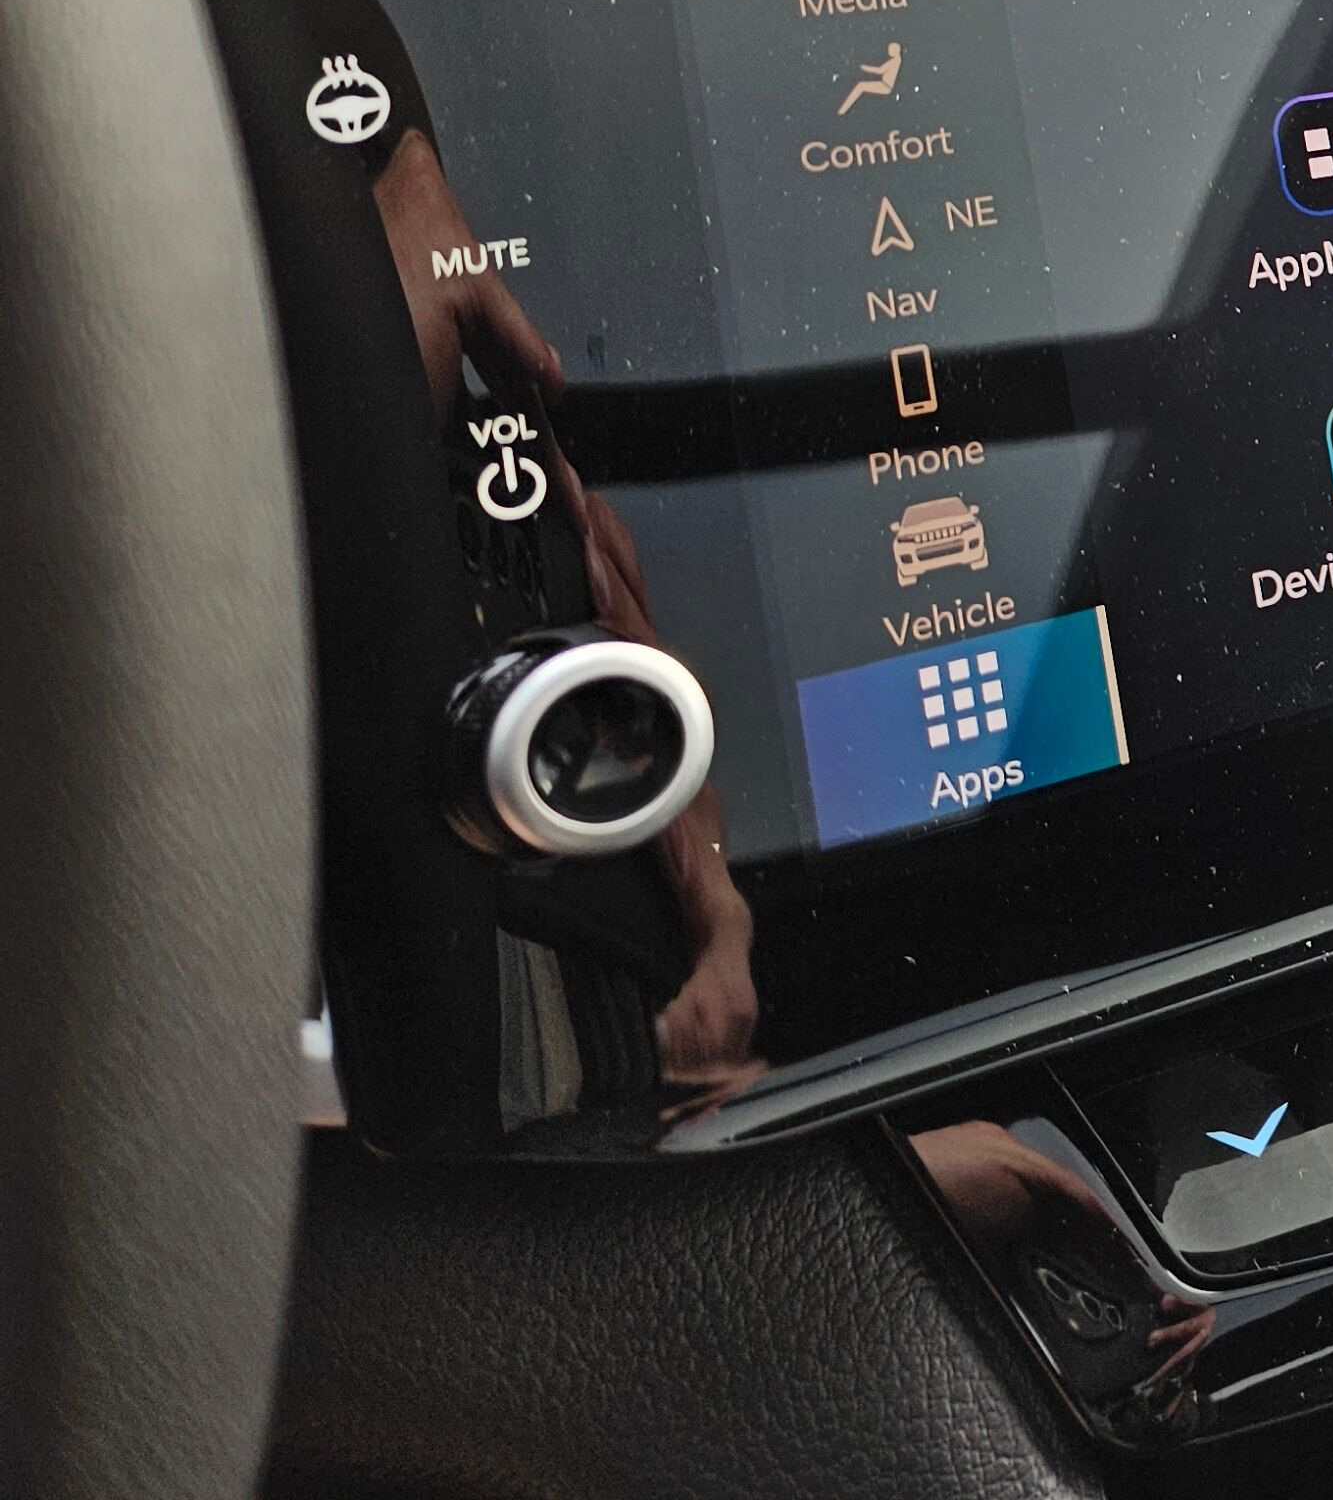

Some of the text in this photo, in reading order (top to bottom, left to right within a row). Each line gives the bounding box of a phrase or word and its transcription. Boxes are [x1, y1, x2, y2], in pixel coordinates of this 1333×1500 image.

[801, 127, 953, 172] Comfort
[945, 196, 998, 231] NE
[432, 237, 531, 280] MUTE
[866, 289, 937, 322] Nav
[467, 412, 537, 450] VOL
[868, 439, 985, 485] Phone
[883, 592, 1016, 647] Vehicle
[930, 757, 1026, 808] Apps
